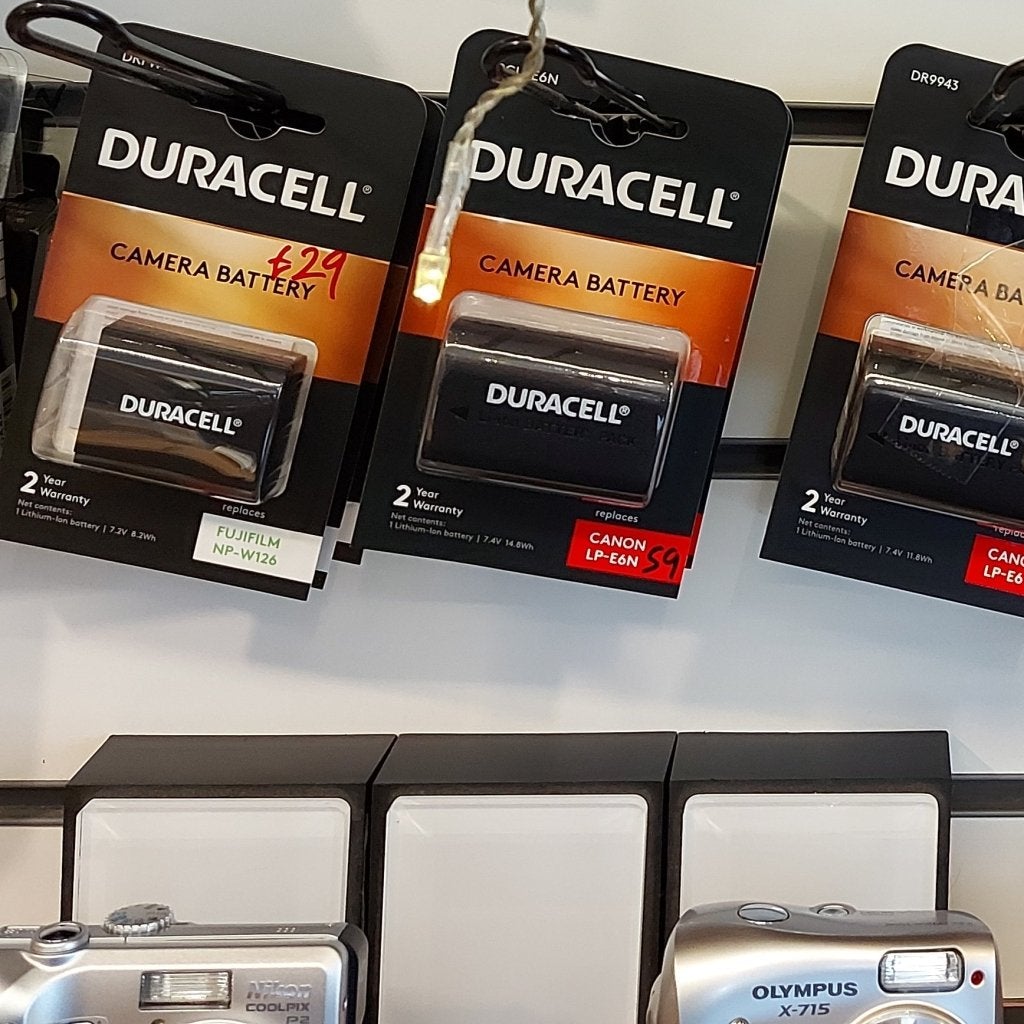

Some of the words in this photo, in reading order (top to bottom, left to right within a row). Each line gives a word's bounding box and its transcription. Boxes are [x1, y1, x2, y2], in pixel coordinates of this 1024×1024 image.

[910, 69, 960, 92] DR9943
[97, 127, 366, 223] DURACELL
[470, 139, 733, 229] DURACELL
[110, 242, 210, 279] CAMERA
[216, 265, 316, 300] BATTERY
[479, 254, 579, 289] CAMERA
[586, 273, 686, 307] BATTERY
[895, 260, 989, 299] CAMERA
[486, 382, 622, 426] DURACELL
[119, 394, 236, 436] DURACELL
[899, 414, 1013, 457] DURACELL
[42, 473, 67, 488] Year
[39, 486, 91, 507] Warranty
[415, 486, 439, 501] Year
[823, 493, 846, 507] Year
[222, 502, 266, 520] replaces
[413, 498, 464, 518] Warranty
[595, 508, 639, 524] replaces
[820, 505, 868, 526] Warranty
[216, 526, 281, 549] FUJIFILM
[589, 532, 647, 553] CANON
[212, 543, 278, 566] NP-W126
[585, 548, 639, 568] LP-E6N
[983, 565, 1024, 586] LP-E6
[752, 982, 859, 1000] OLYMPUS
[246, 1003, 310, 1011] COOLPIX
[778, 1003, 831, 1018] X-715
